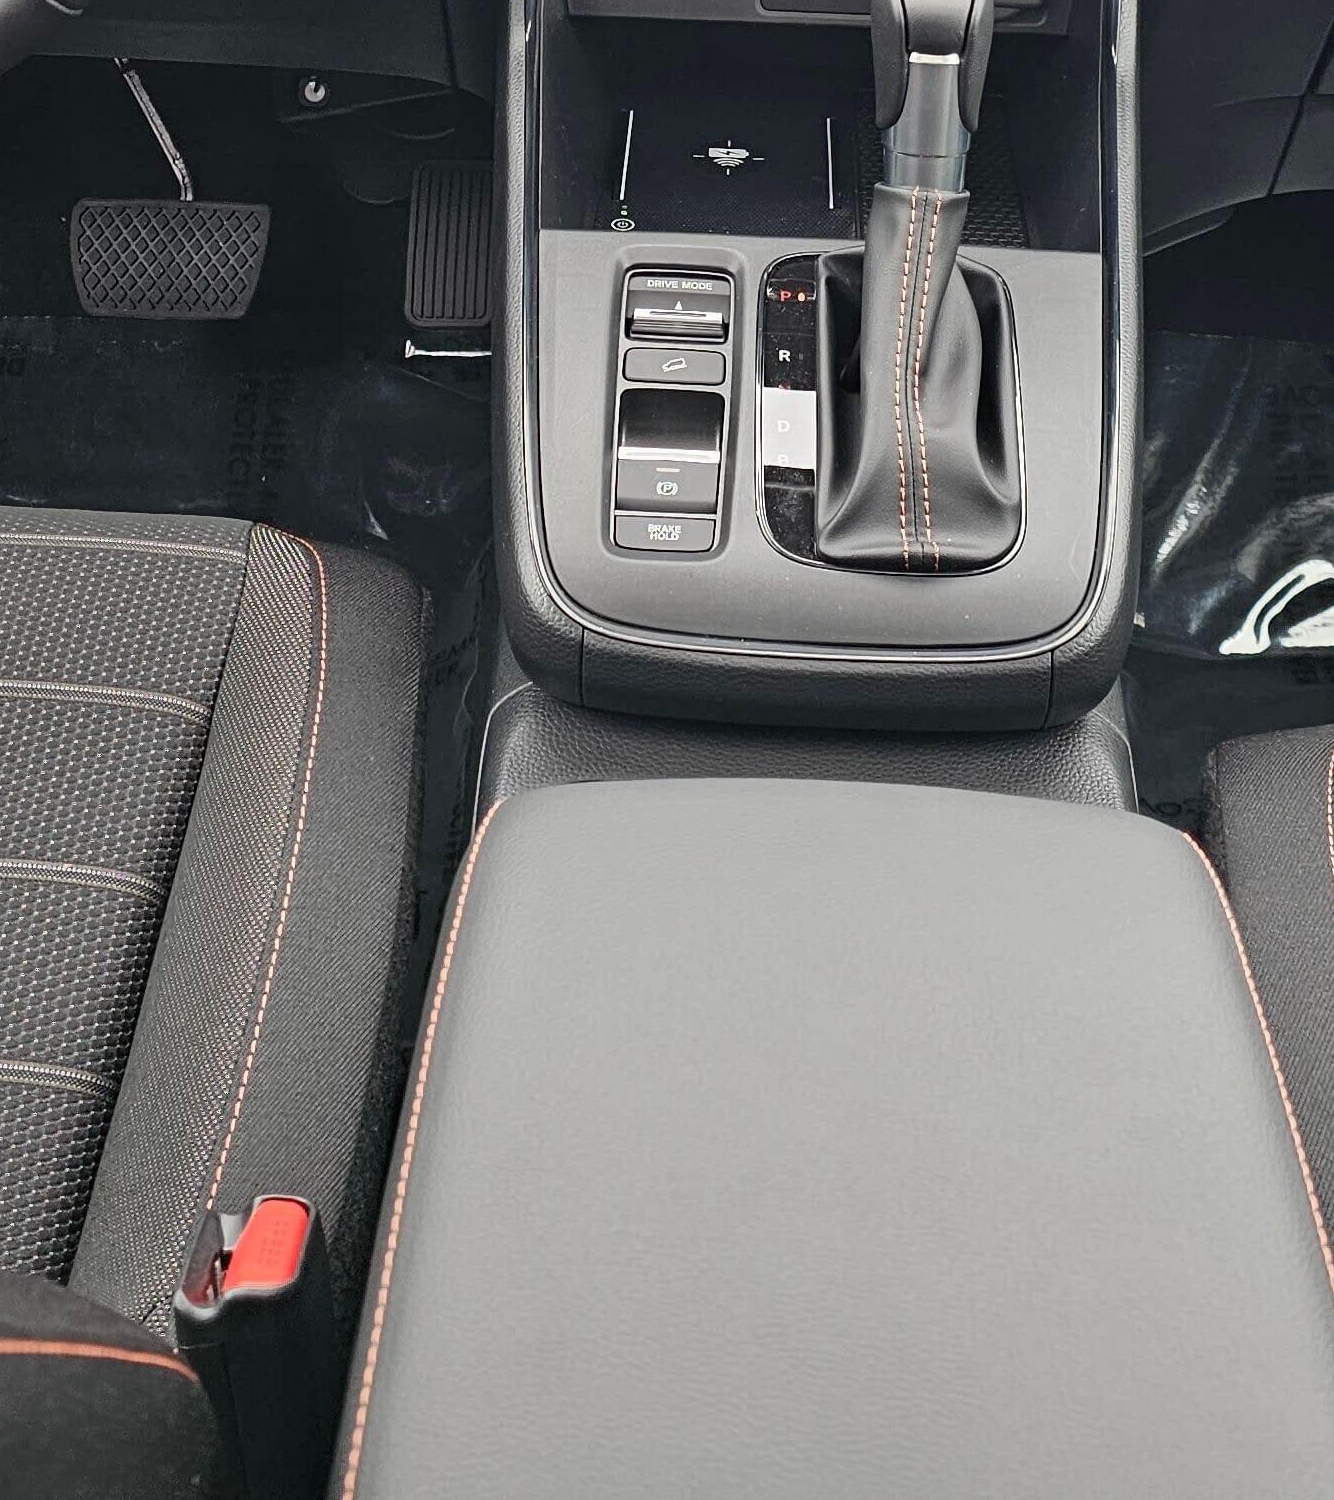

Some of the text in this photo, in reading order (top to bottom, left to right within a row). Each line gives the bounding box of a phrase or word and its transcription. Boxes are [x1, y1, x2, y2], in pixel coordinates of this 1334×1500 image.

[647, 279, 713, 290] DRIVE MODE
[780, 290, 791, 301] P
[779, 349, 791, 362] R
[778, 420, 790, 432] D
[647, 523, 681, 533] BRAKE
[649, 532, 680, 541] HOLD
